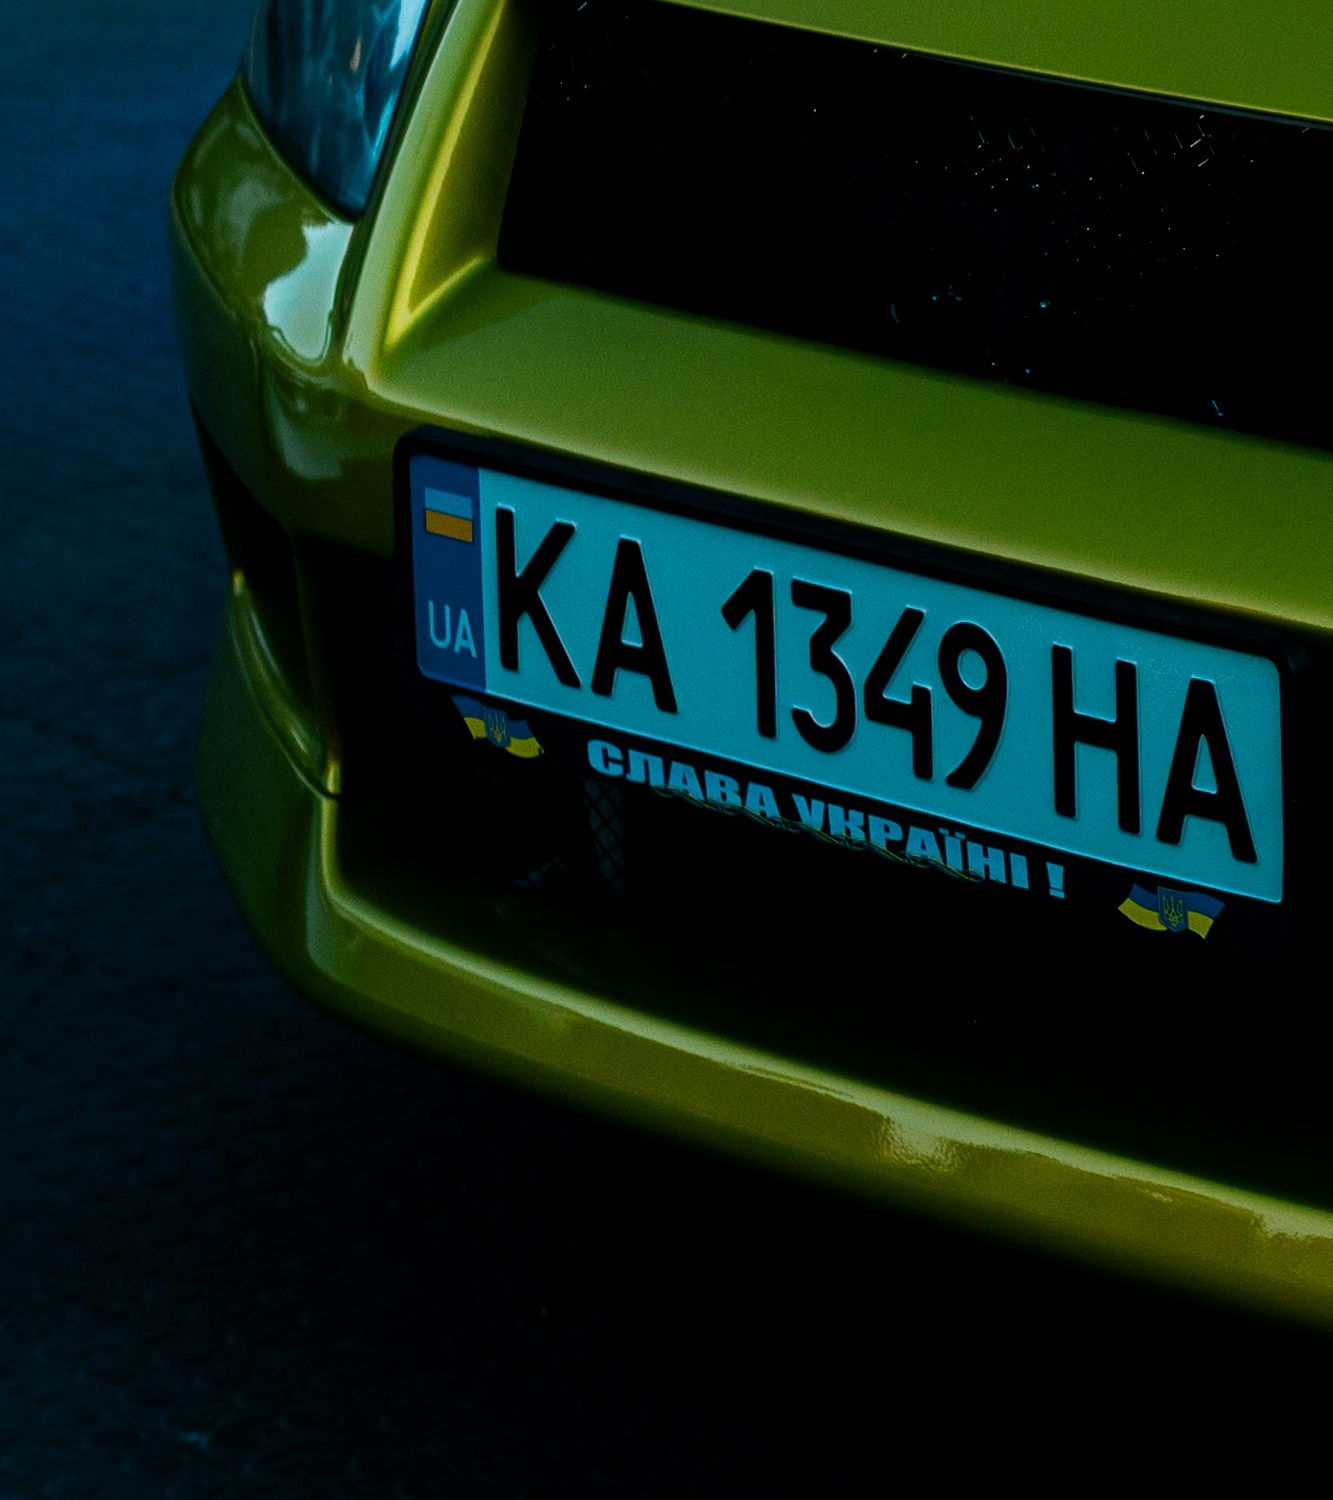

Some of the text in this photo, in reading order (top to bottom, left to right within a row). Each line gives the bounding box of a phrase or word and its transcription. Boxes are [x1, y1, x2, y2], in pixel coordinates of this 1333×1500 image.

[426, 598, 478, 659] UA
[494, 503, 1259, 865] KA 1349 HA
[586, 739, 782, 820] СЛАВА
[790, 792, 1030, 890] УКРАЇНІ
